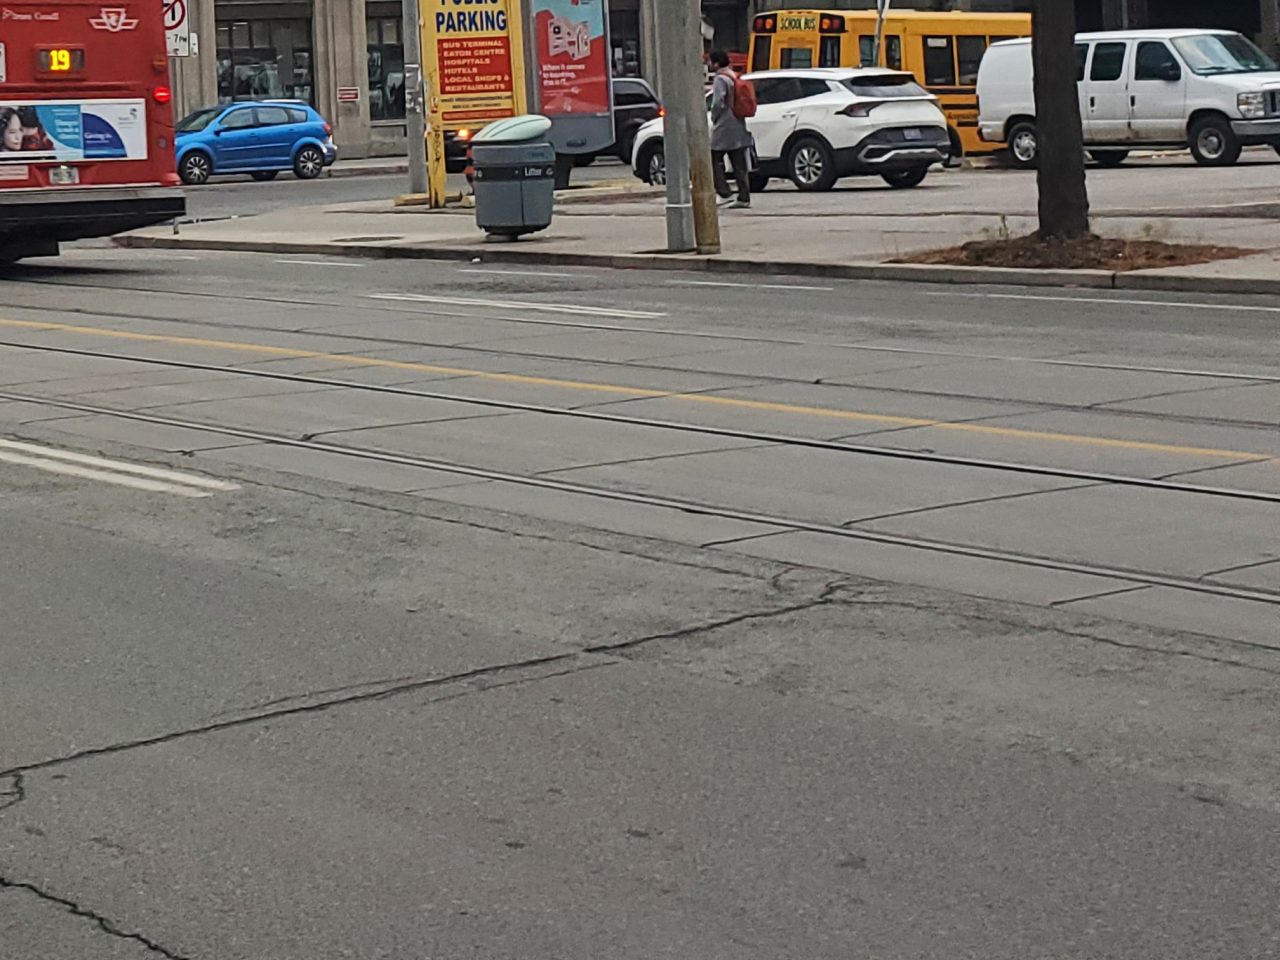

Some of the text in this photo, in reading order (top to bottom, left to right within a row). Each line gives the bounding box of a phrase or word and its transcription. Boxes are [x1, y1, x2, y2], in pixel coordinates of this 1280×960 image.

[436, 10, 507, 33] PARKING
[780, 17, 816, 31] SCHOOL BUS
[463, 40, 503, 48] TERMINAL
[473, 48, 505, 56] CENTRE
[50, 49, 70, 71] 19
[444, 58, 490, 66] HOSPITALS
[444, 67, 477, 75] HOTELS
[445, 84, 505, 92] RESTAURANTS
[524, 167, 542, 177] Litter
